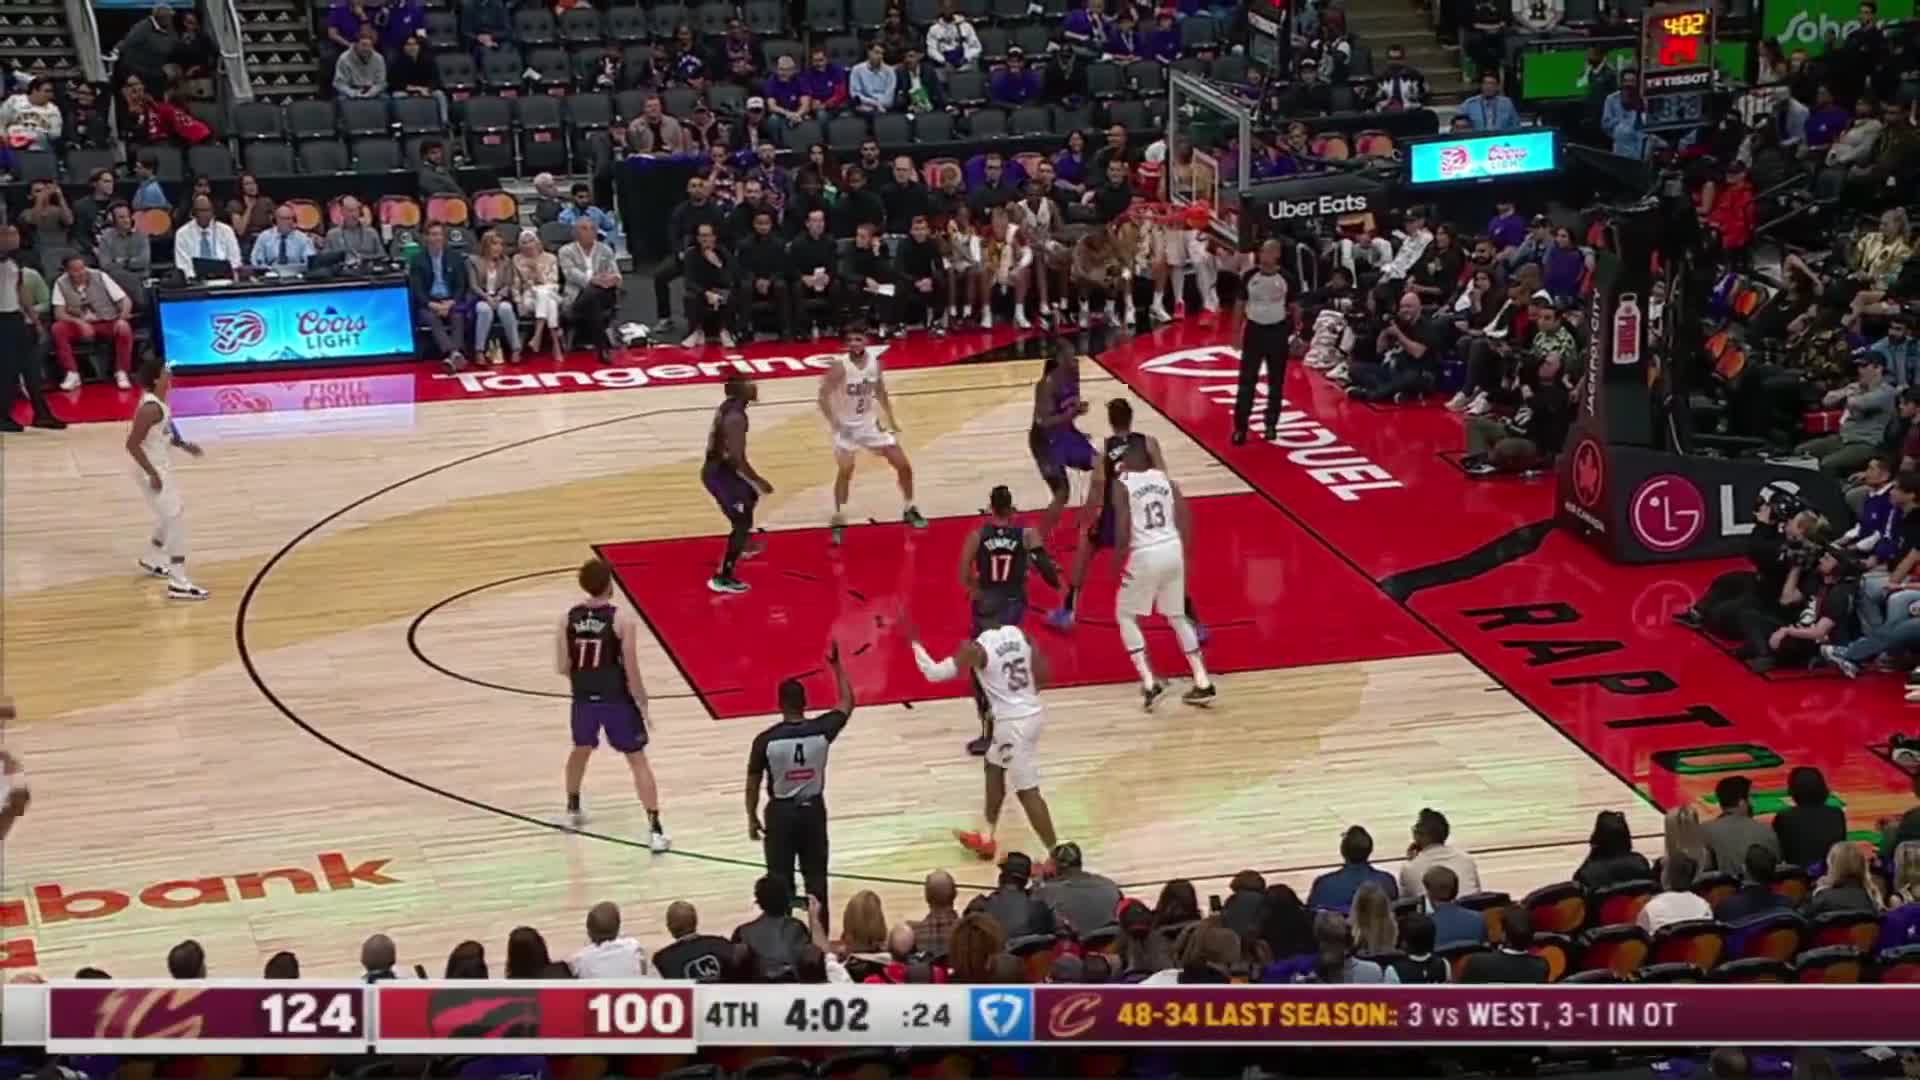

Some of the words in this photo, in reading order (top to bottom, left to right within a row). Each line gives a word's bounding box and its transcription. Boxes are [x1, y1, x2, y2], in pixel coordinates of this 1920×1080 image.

[1269, 201, 1316, 219] Uber
[1319, 195, 1367, 212] Eats
[296, 310, 368, 335] Coors
[1592, 287, 1600, 331] CITY
[306, 333, 363, 350] LIGHT
[1587, 334, 1599, 417] JACKPOT
[1143, 501, 1166, 529] 13
[990, 554, 1013, 582] 17
[576, 638, 602, 669] 77
[1002, 657, 1029, 692] 35
[794, 743, 806, 766] 4
